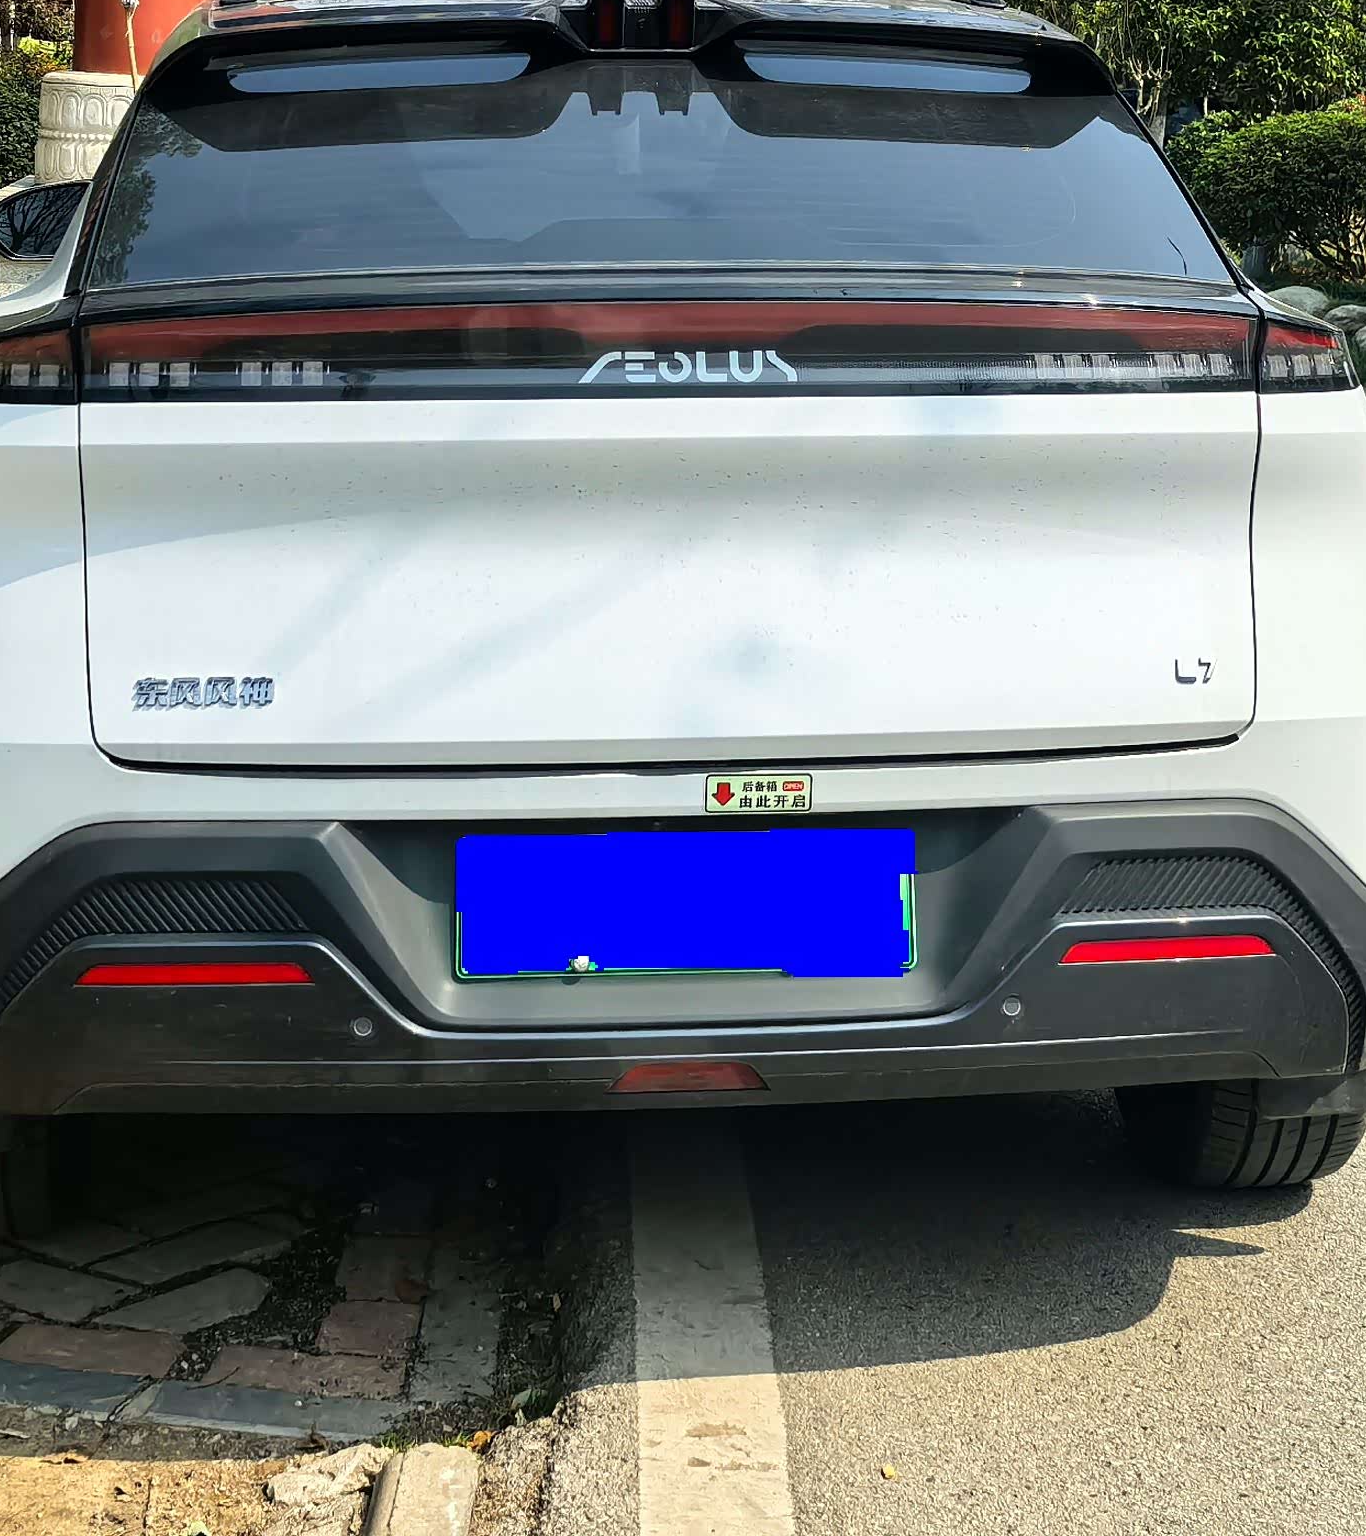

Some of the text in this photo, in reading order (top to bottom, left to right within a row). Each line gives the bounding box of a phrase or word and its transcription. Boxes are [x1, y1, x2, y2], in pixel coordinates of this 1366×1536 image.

[578, 350, 798, 383] AEOLUS
[1174, 657, 1217, 684] L7
[132, 676, 275, 710] 东风风神
[742, 781, 777, 792] 后备箱
[739, 794, 806, 809] 由此开启
